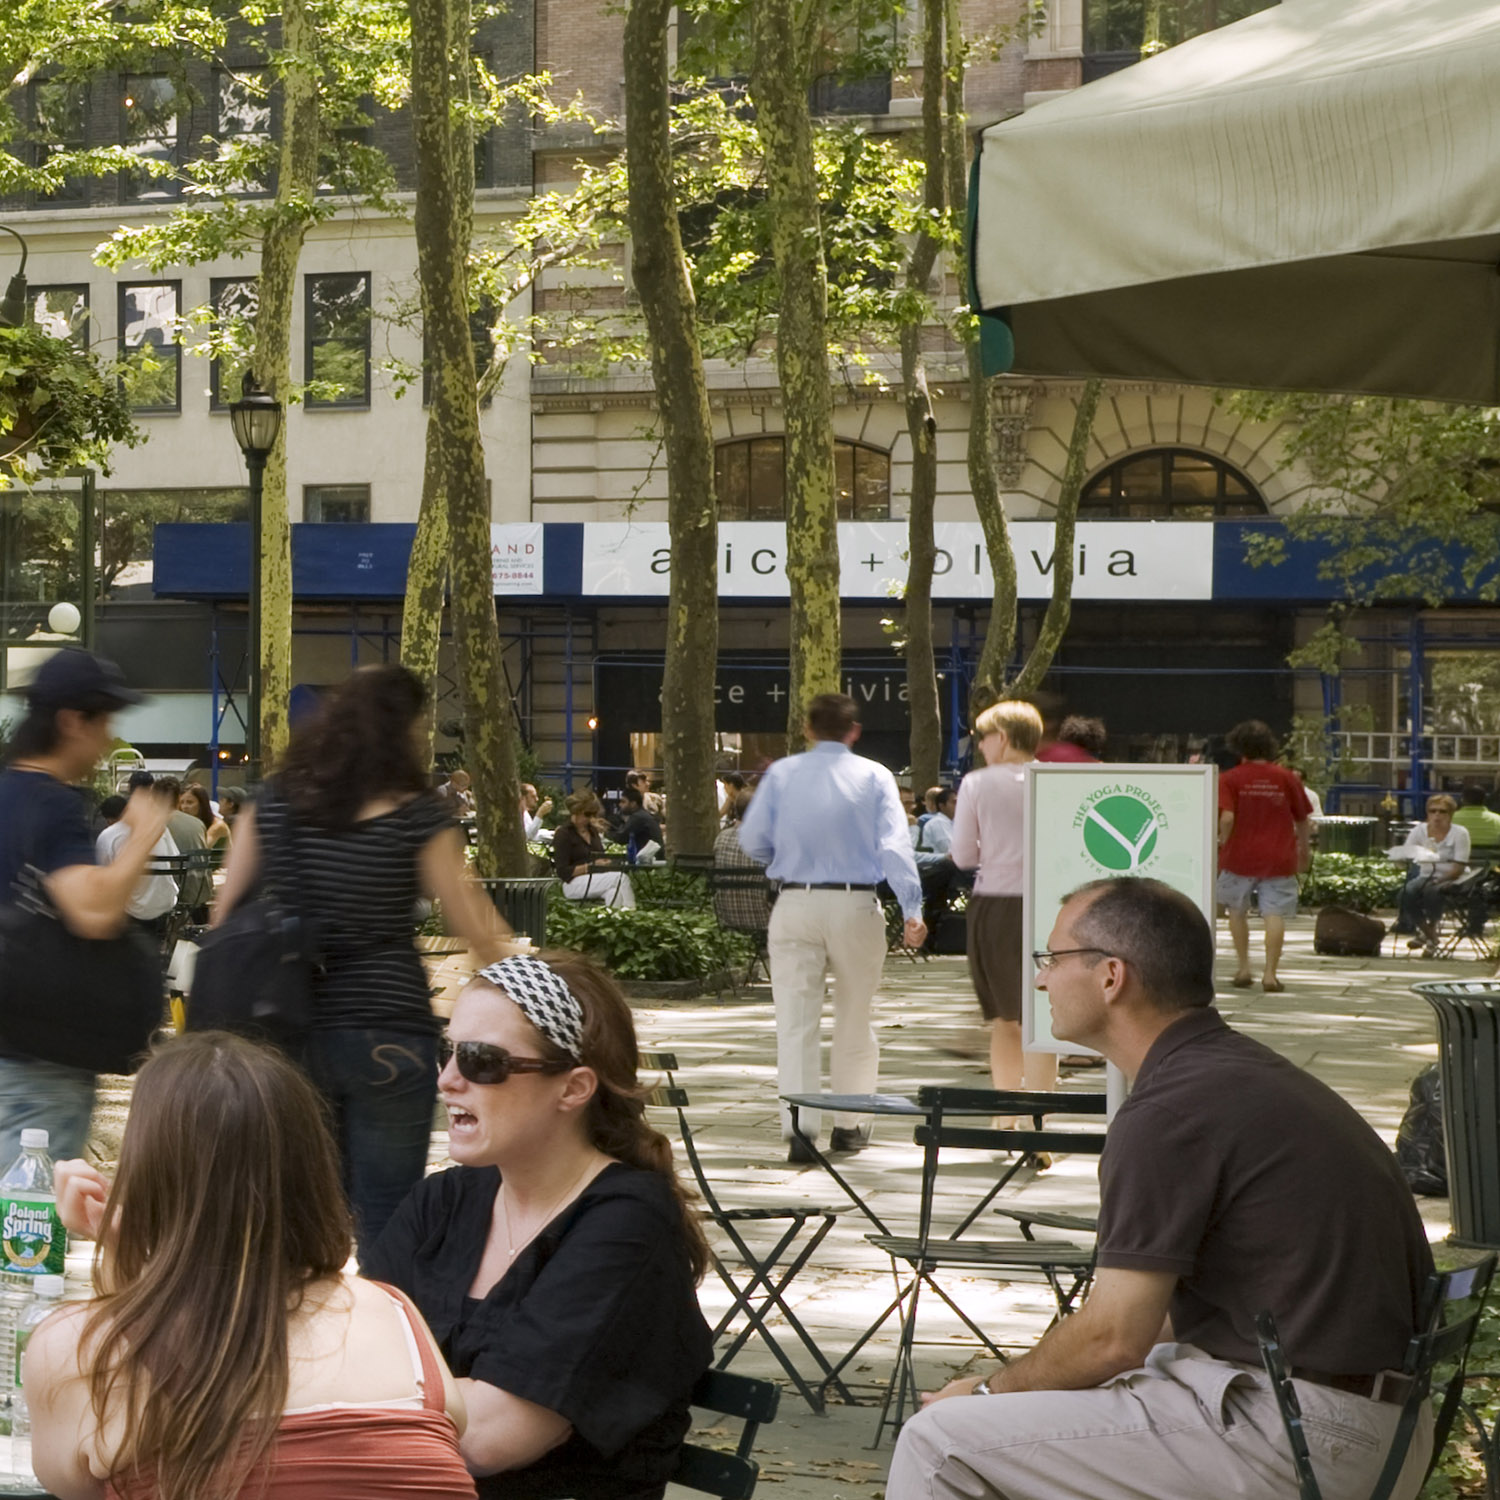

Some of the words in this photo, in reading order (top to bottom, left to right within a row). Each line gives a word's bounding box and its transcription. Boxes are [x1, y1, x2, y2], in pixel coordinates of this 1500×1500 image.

[650, 543, 777, 576] aic
[930, 543, 1138, 576] olvia
[847, 677, 910, 704] ivia
[1072, 802, 1090, 830] THE
[1086, 784, 1122, 804] YOGA
[1125, 784, 1169, 830] PROJECT
[9, 1202, 49, 1219] Poland
[2, 1215, 53, 1243] Spring
